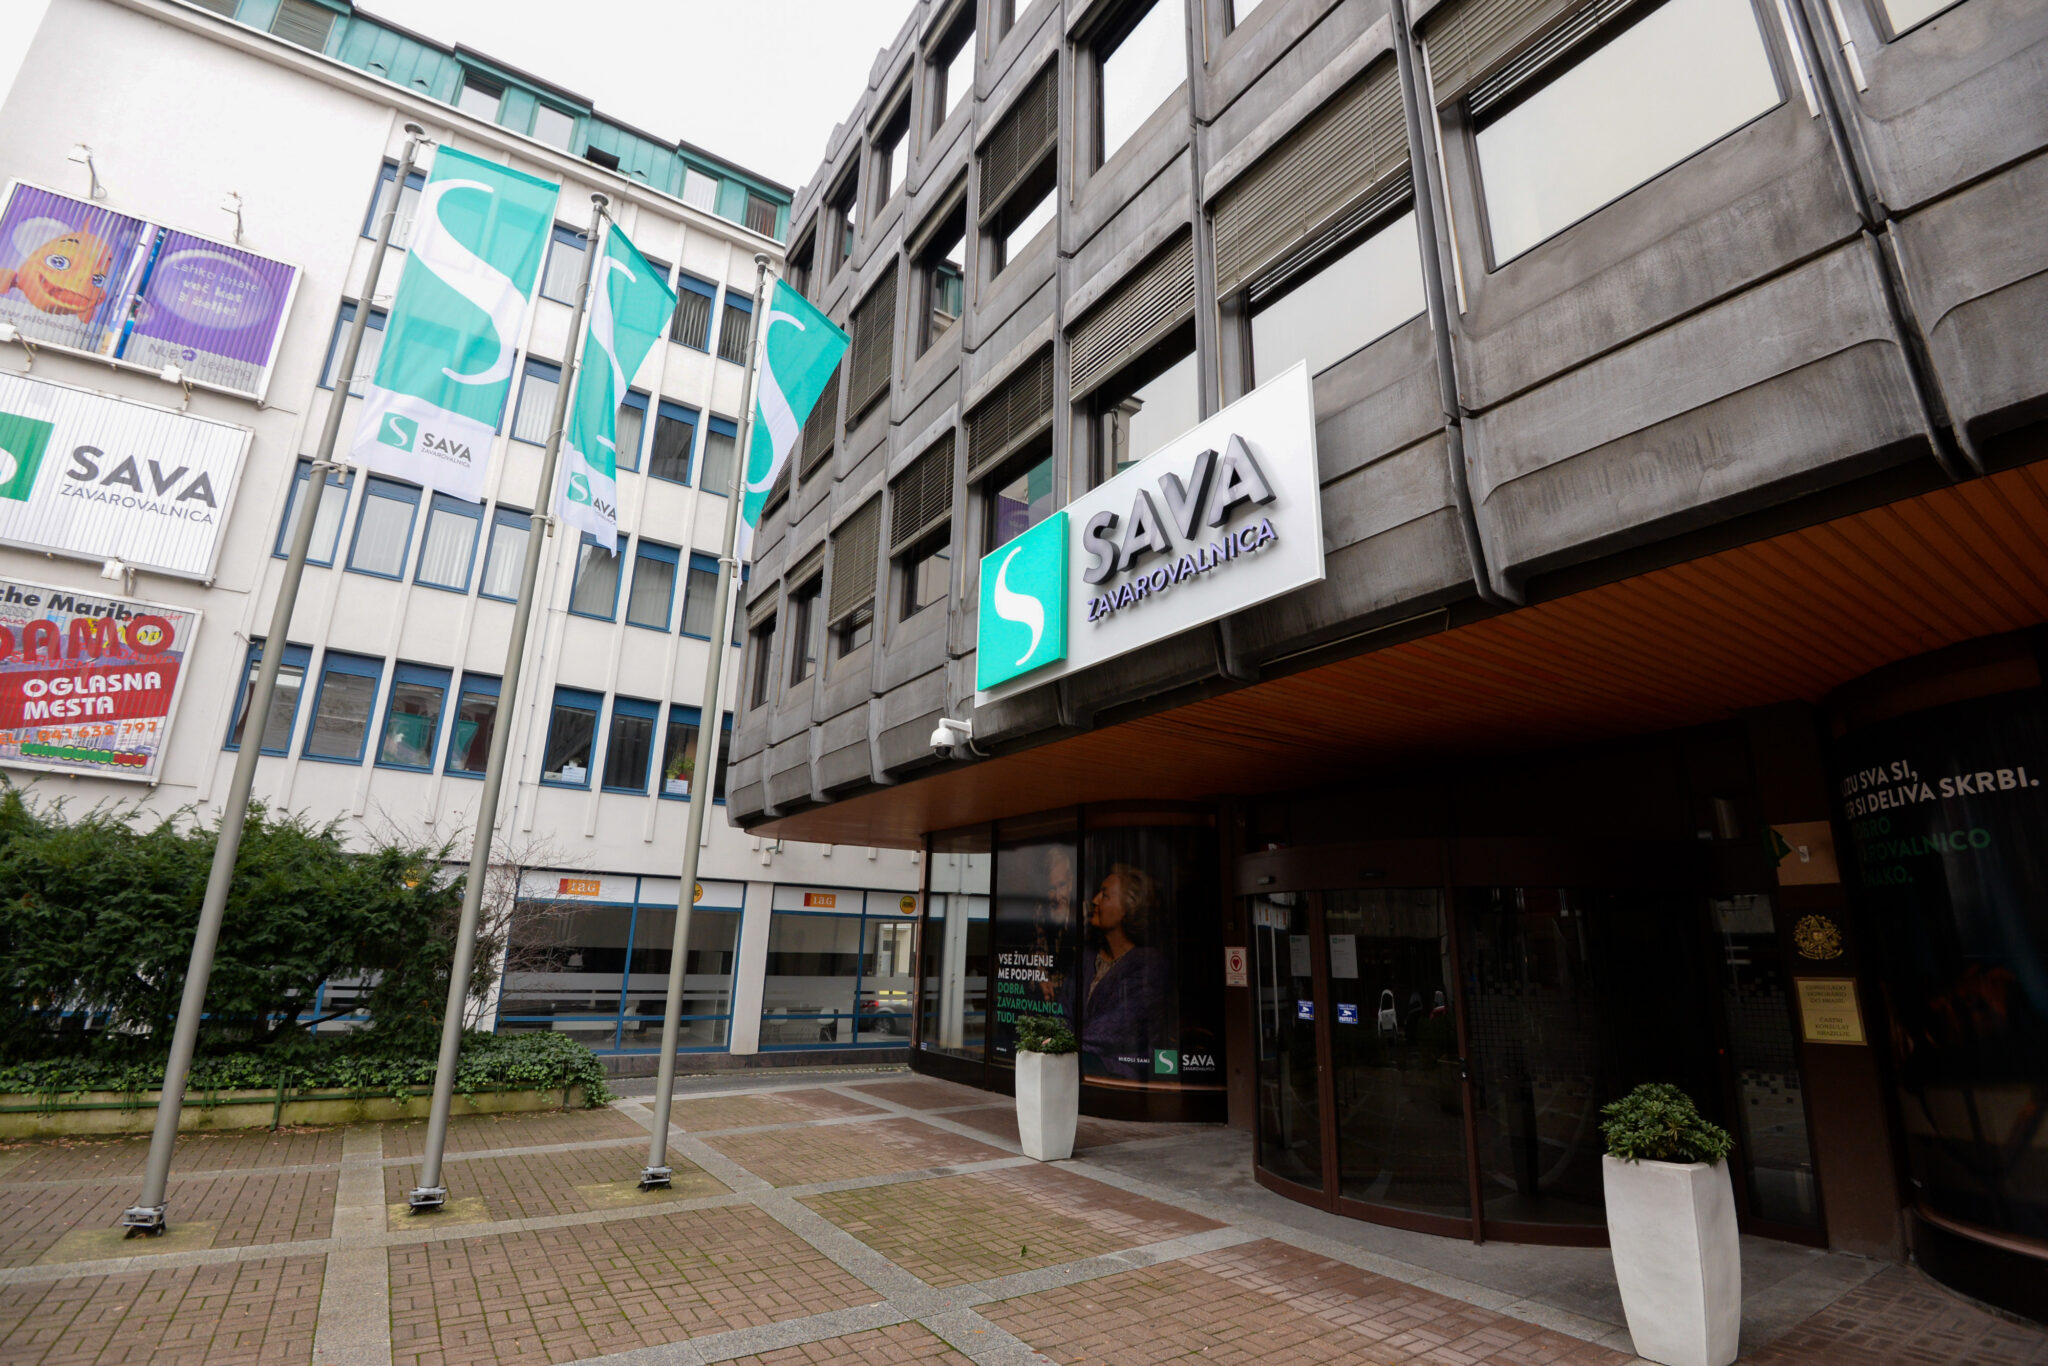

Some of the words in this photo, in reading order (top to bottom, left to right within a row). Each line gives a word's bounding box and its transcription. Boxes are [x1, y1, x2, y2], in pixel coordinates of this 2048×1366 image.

[173, 262, 216, 279] Lahko
[219, 273, 259, 292] imate
[148, 344, 179, 360] NLB
[200, 357, 251, 380] Leasing
[420, 448, 471, 468] ZAVAROVALNICA
[423, 433, 472, 462] SAVA
[66, 445, 217, 508] SAVA
[61, 484, 213, 525] ZAVAROVALNICA
[592, 497, 616, 521] AVA
[1082, 433, 1277, 586] SAVA
[1087, 517, 1279, 622] ZAVAROVALNICA
[23, 672, 161, 697] OGLASNA
[24, 696, 114, 720] MESTA
[38, 728, 72, 742] 041
[78, 724, 115, 739] 632
[122, 721, 157, 736] 797
[1859, 766, 1890, 790] SVA
[1890, 760, 1918, 782] SI,
[1856, 796, 1867, 816] SI
[1868, 782, 1937, 813] DELIVA
[1939, 766, 2041, 799] SKRBI.
[998, 953, 1013, 966] VSE
[1014, 950, 1054, 967] ŽIVLJENJE
[998, 968, 1010, 979] ME
[1011, 969, 1049, 982] PODPIRA.
[998, 982, 1025, 995] DOBRA
[997, 996, 1064, 1015] ZAVAROVALNICA
[1182, 1054, 1215, 1066] SAVA
